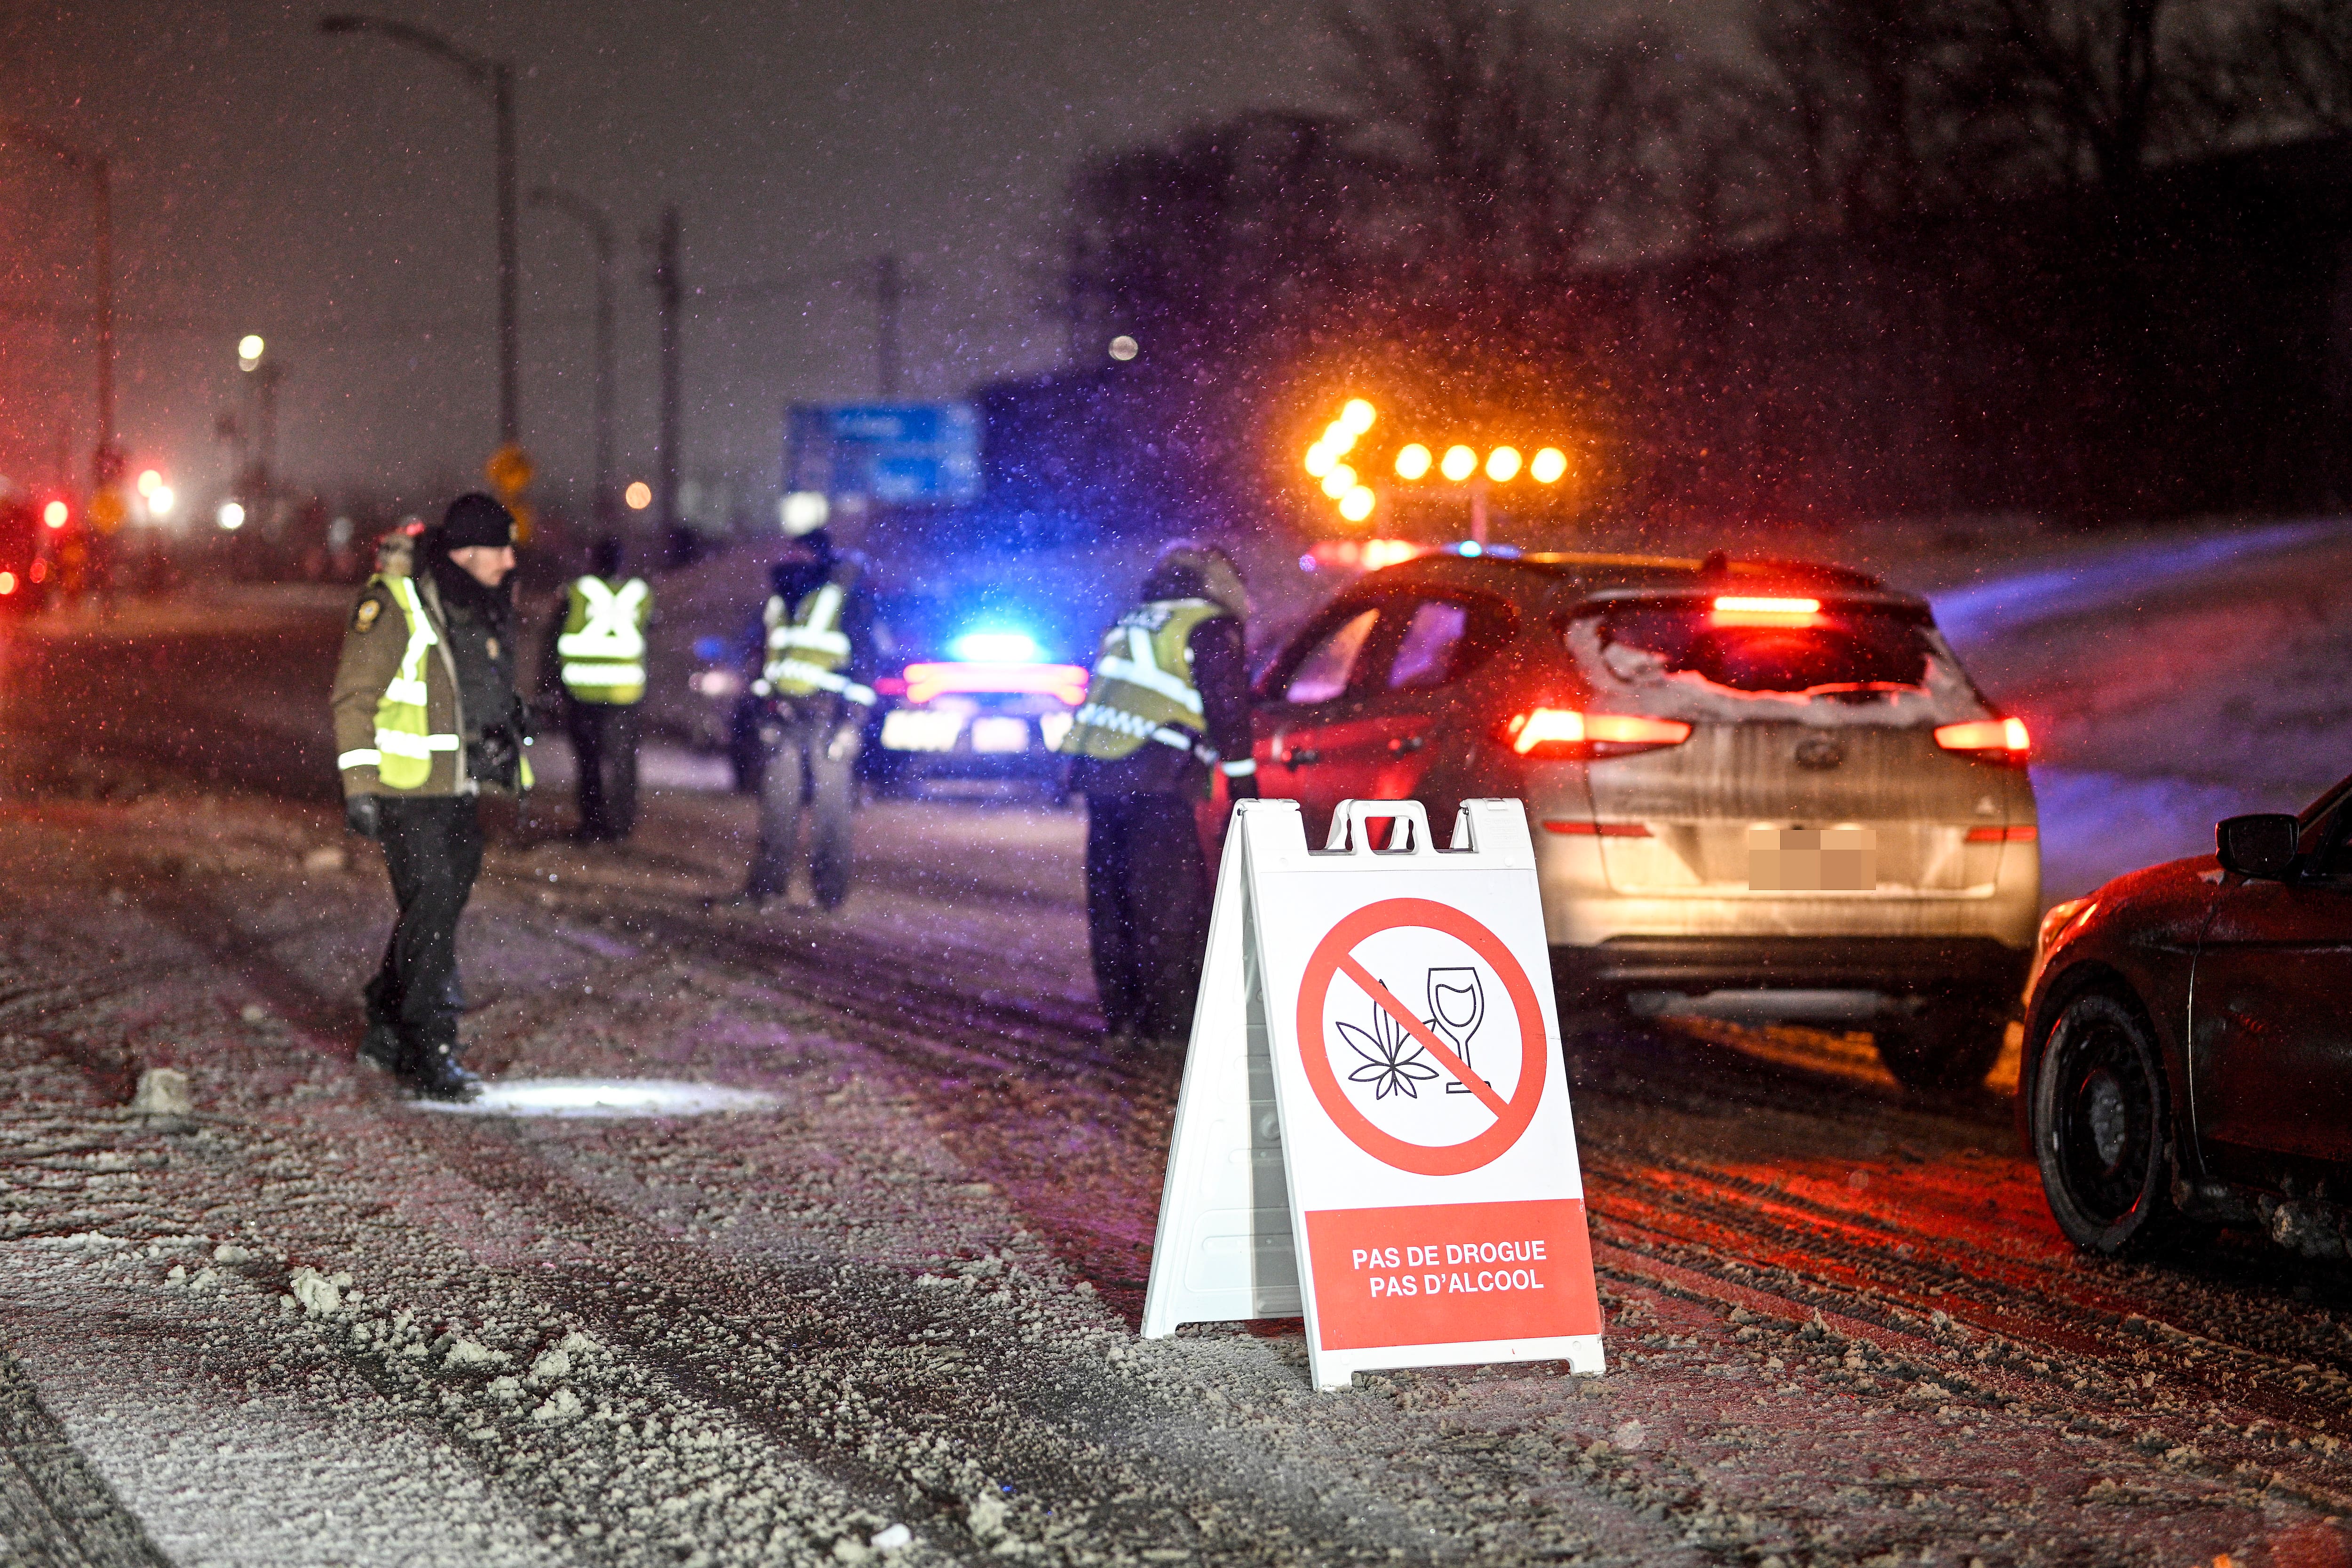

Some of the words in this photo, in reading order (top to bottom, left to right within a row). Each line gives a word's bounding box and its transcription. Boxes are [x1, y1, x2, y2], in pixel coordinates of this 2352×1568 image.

[1352, 1248, 1400, 1269] PAS
[1406, 1246, 1439, 1266] DE
[1446, 1241, 1546, 1264] DROGUE
[1370, 1275, 1417, 1297] PAS
